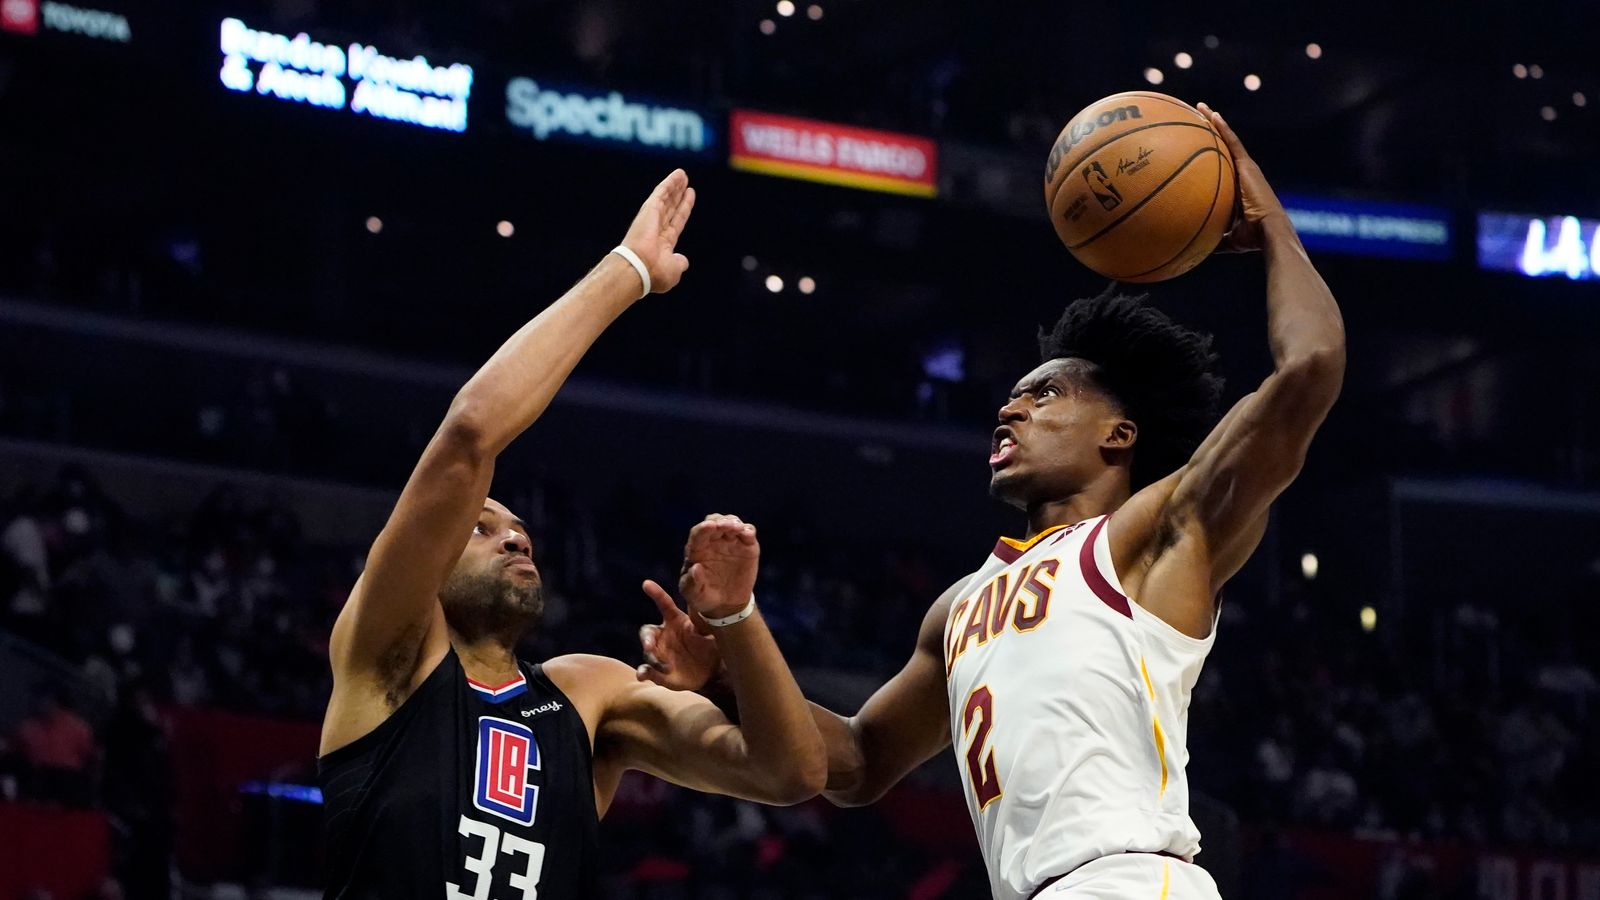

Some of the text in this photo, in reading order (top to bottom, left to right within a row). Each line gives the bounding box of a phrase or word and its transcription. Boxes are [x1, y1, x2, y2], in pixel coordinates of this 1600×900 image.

[41, 2, 132, 42] TOYOTA
[505, 76, 706, 151] Spectrum
[740, 121, 927, 178] WELLS FARGO
[945, 557, 1060, 681] CAVS
[520, 700, 564, 718] oney
[963, 684, 1002, 813] 2
[445, 813, 546, 900] 33
